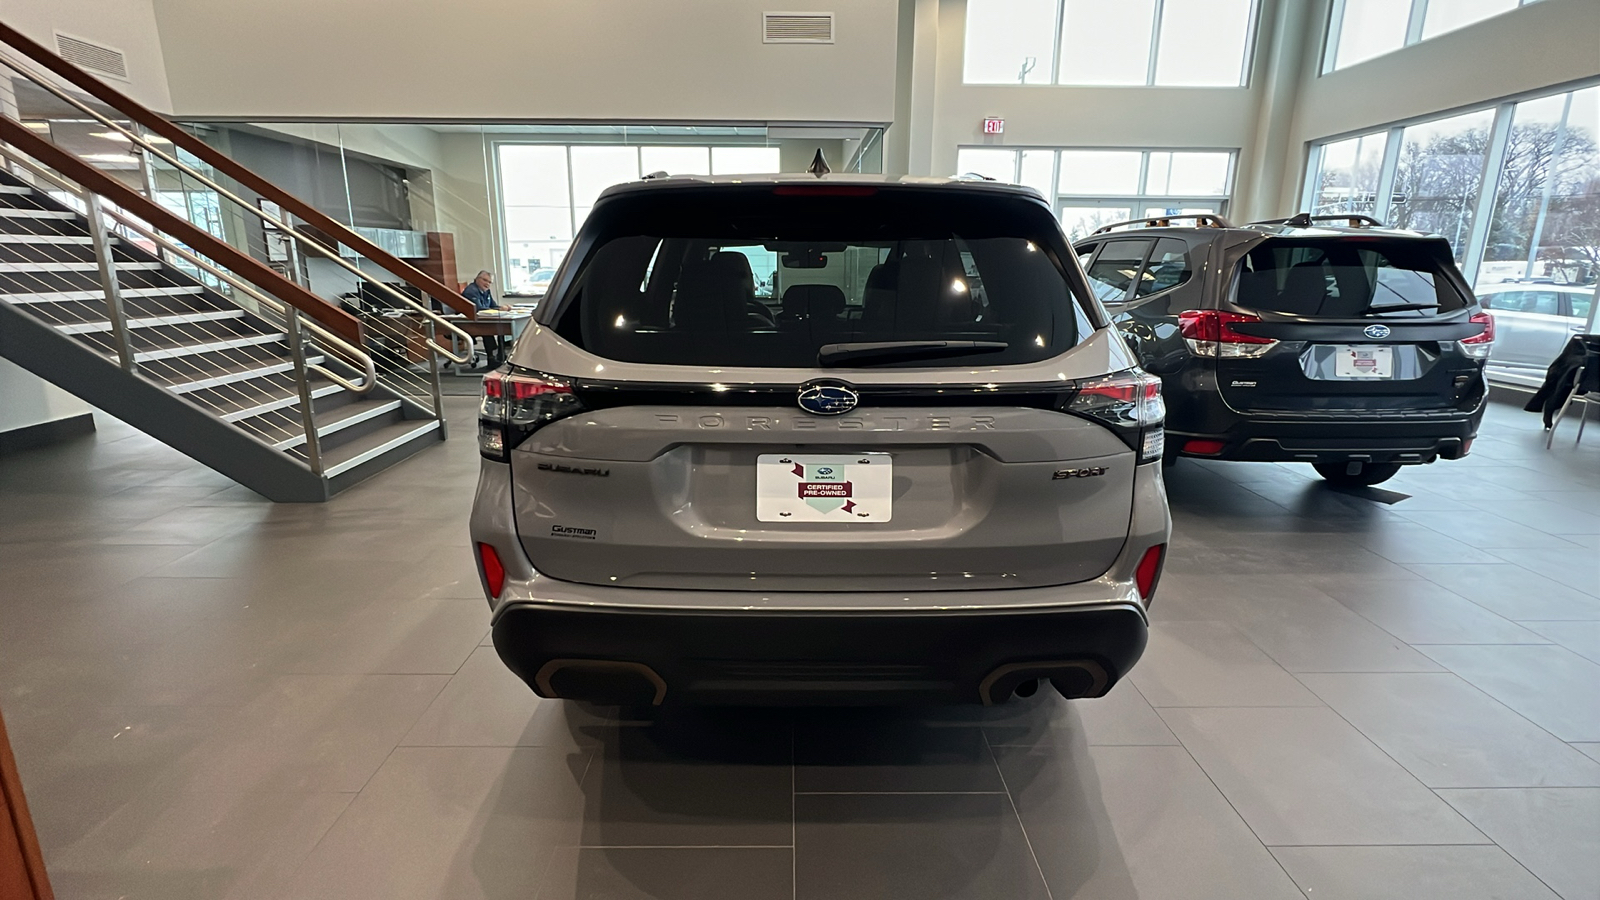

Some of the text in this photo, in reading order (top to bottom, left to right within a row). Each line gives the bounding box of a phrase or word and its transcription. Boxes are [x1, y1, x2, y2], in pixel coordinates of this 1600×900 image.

[655, 414, 996, 431] FORESTER
[537, 463, 610, 477] SUBARU
[1052, 466, 1109, 480] SPORT
